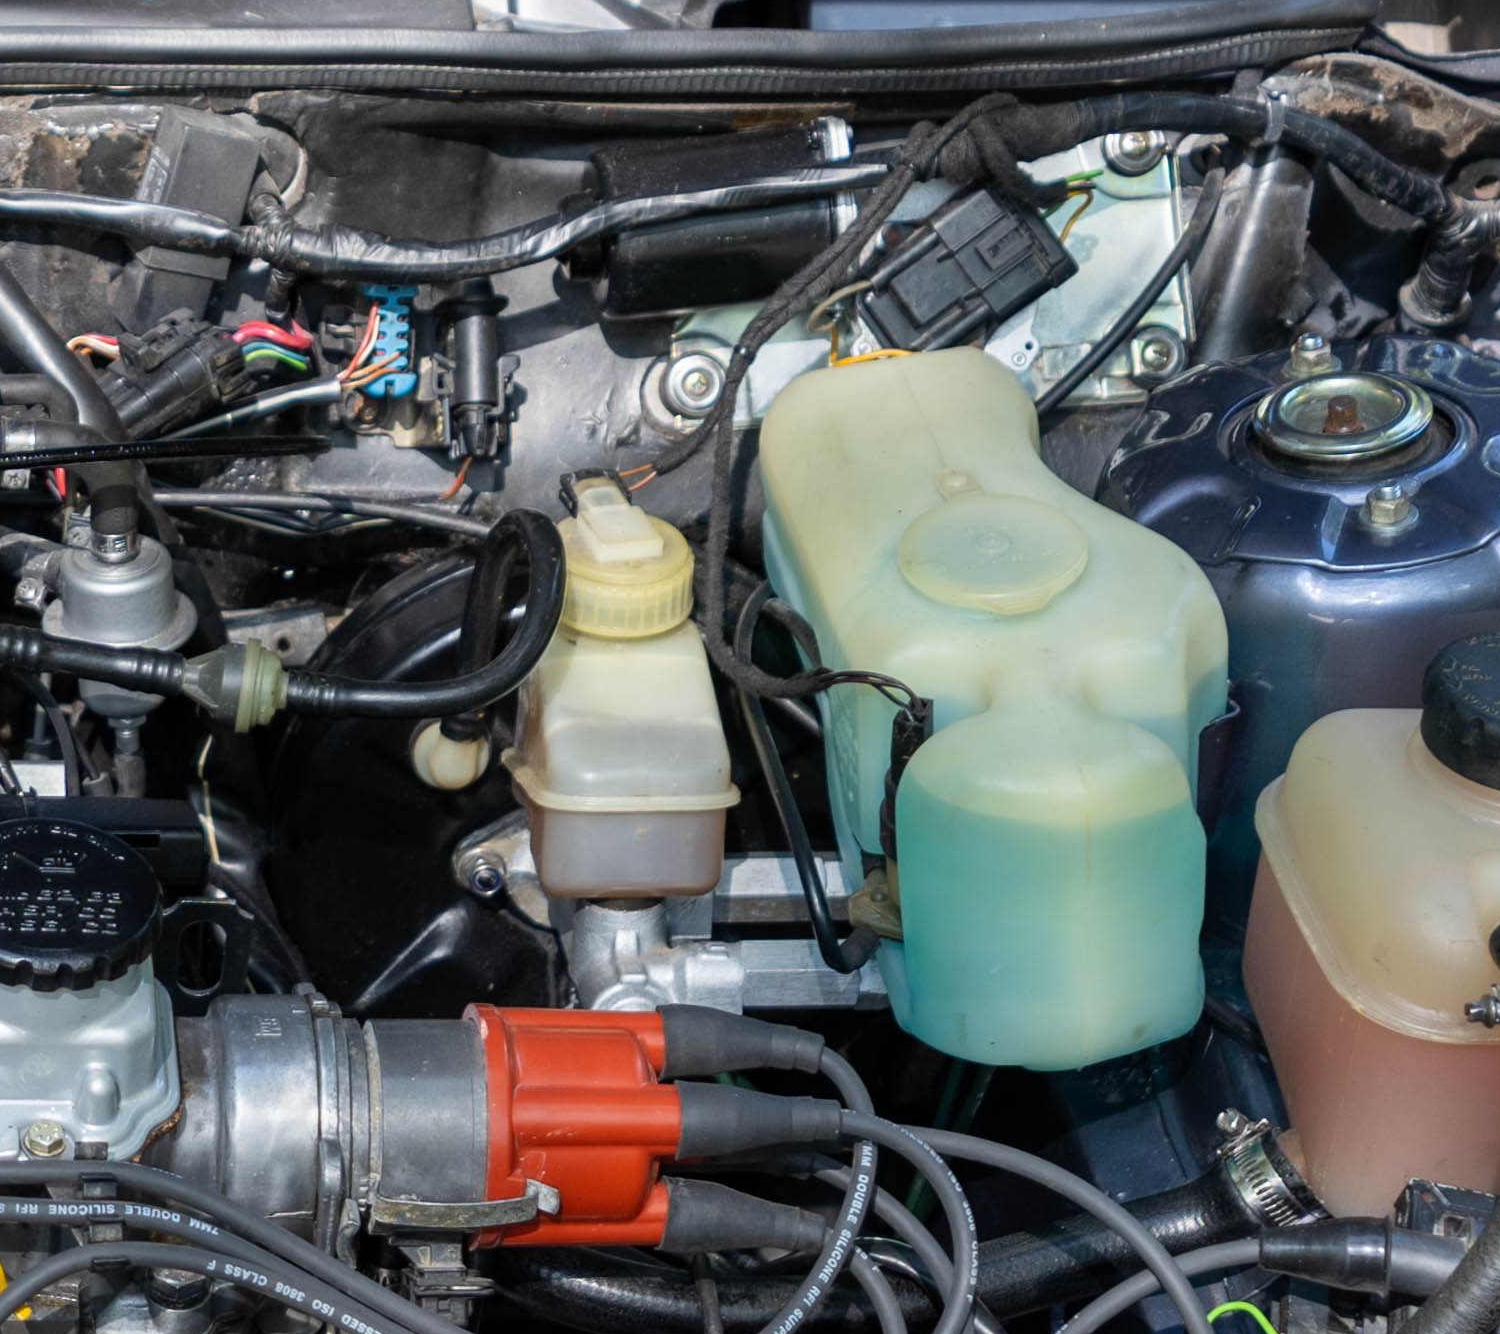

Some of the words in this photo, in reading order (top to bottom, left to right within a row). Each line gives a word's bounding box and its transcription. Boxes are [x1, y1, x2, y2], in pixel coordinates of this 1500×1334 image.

[14, 1202, 39, 1216] RFI
[47, 1202, 116, 1218] SILICONE
[846, 1173, 871, 1226] DOUBLE
[122, 1202, 181, 1225] DOUBLE
[188, 1216, 219, 1236] 7MM
[206, 1258, 217, 1271] F
[818, 1228, 852, 1284] SILICONE
[223, 1262, 269, 1286] CLASS
[802, 1284, 822, 1308] RFI
[311, 1297, 337, 1318] ISO
